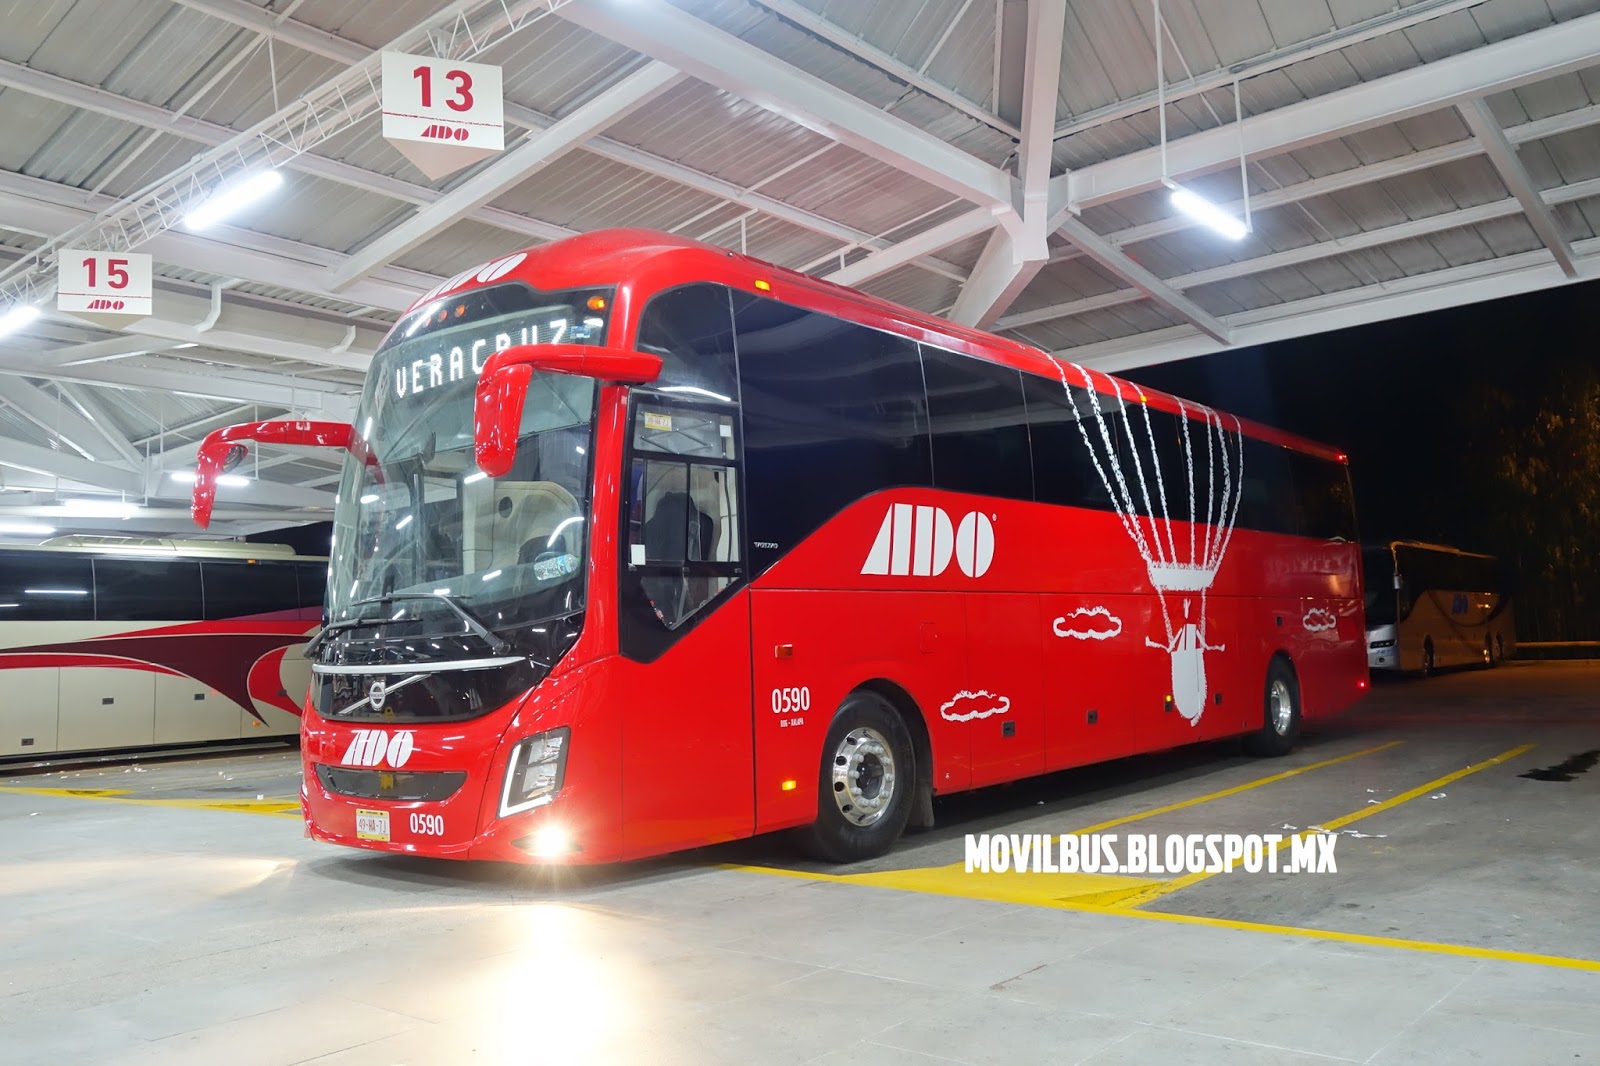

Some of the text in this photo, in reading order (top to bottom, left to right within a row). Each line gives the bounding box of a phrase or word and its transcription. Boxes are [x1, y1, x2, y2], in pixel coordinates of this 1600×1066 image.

[413, 65, 474, 112] 13
[420, 124, 469, 141] ADO
[82, 257, 129, 290] 15
[86, 299, 125, 310] ADO
[860, 503, 995, 578] ADO
[771, 686, 810, 714] 0590
[341, 730, 414, 768] ADO
[359, 818, 387, 833] 49-HA-7J
[410, 813, 444, 836] 0590
